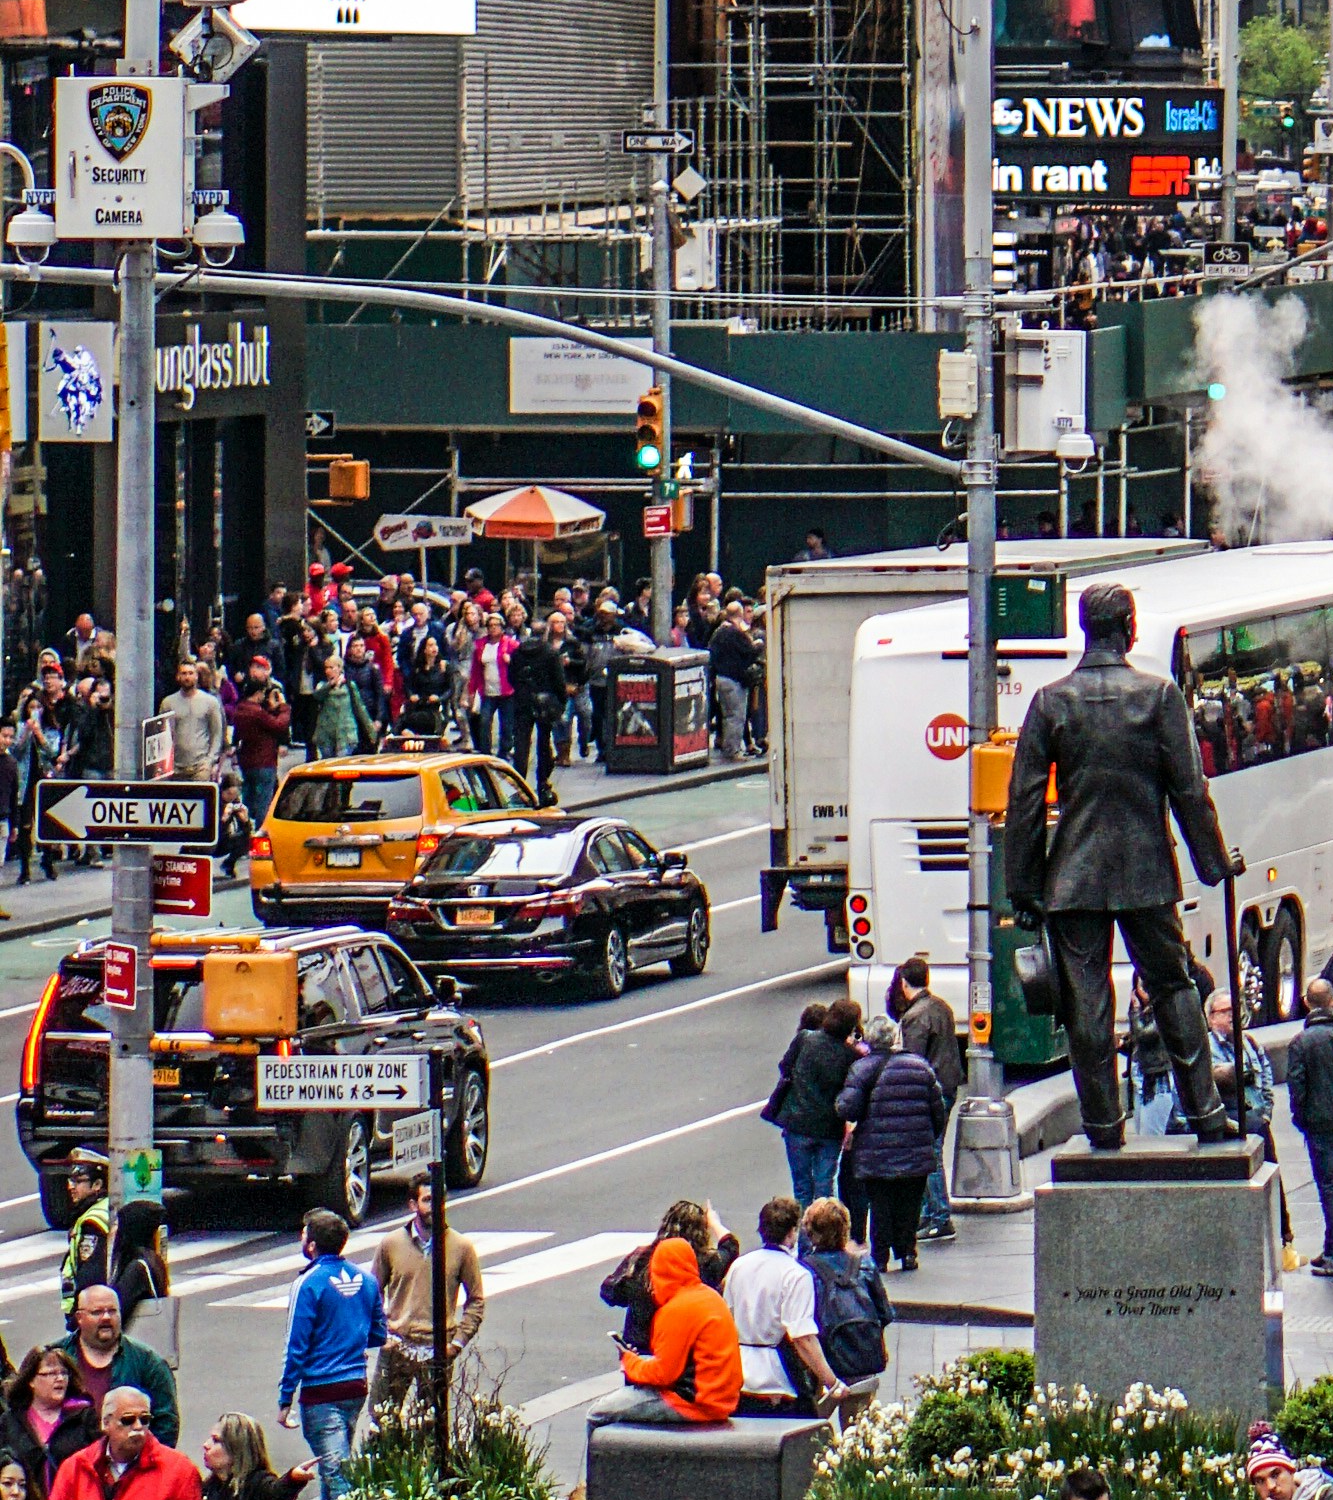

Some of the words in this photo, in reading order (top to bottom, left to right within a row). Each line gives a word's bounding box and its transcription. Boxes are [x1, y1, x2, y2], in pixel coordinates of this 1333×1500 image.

[102, 86, 136, 97] POLICE
[90, 95, 147, 109] DEPARTMENT
[1023, 97, 1146, 138] NEWS
[629, 137, 652, 148] ONE
[661, 137, 684, 148] WAY
[92, 166, 147, 183] SECURITY
[992, 158, 1023, 192] in
[1031, 160, 1108, 192] rant
[1129, 155, 1192, 197] ESPN
[191, 190, 224, 204] NYPD
[95, 207, 143, 225] CAMERA
[235, 321, 271, 388] hut
[91, 801, 139, 825] ONE
[148, 801, 198, 825] WAY
[165, 861, 197, 875] STANDING
[265, 1063, 337, 1080] PEDESTRIAN
[342, 1063, 374, 1079] FLOW
[377, 1062, 409, 1079] ZONE
[265, 1084, 296, 1101] KEEP
[299, 1084, 344, 1101] MOVING
[1126, 1285, 1165, 1301] Grand
[1169, 1285, 1192, 1298] Old
[1193, 1283, 1223, 1301] Flag
[1116, 1301, 1145, 1316] Over
[1148, 1301, 1181, 1315] There
